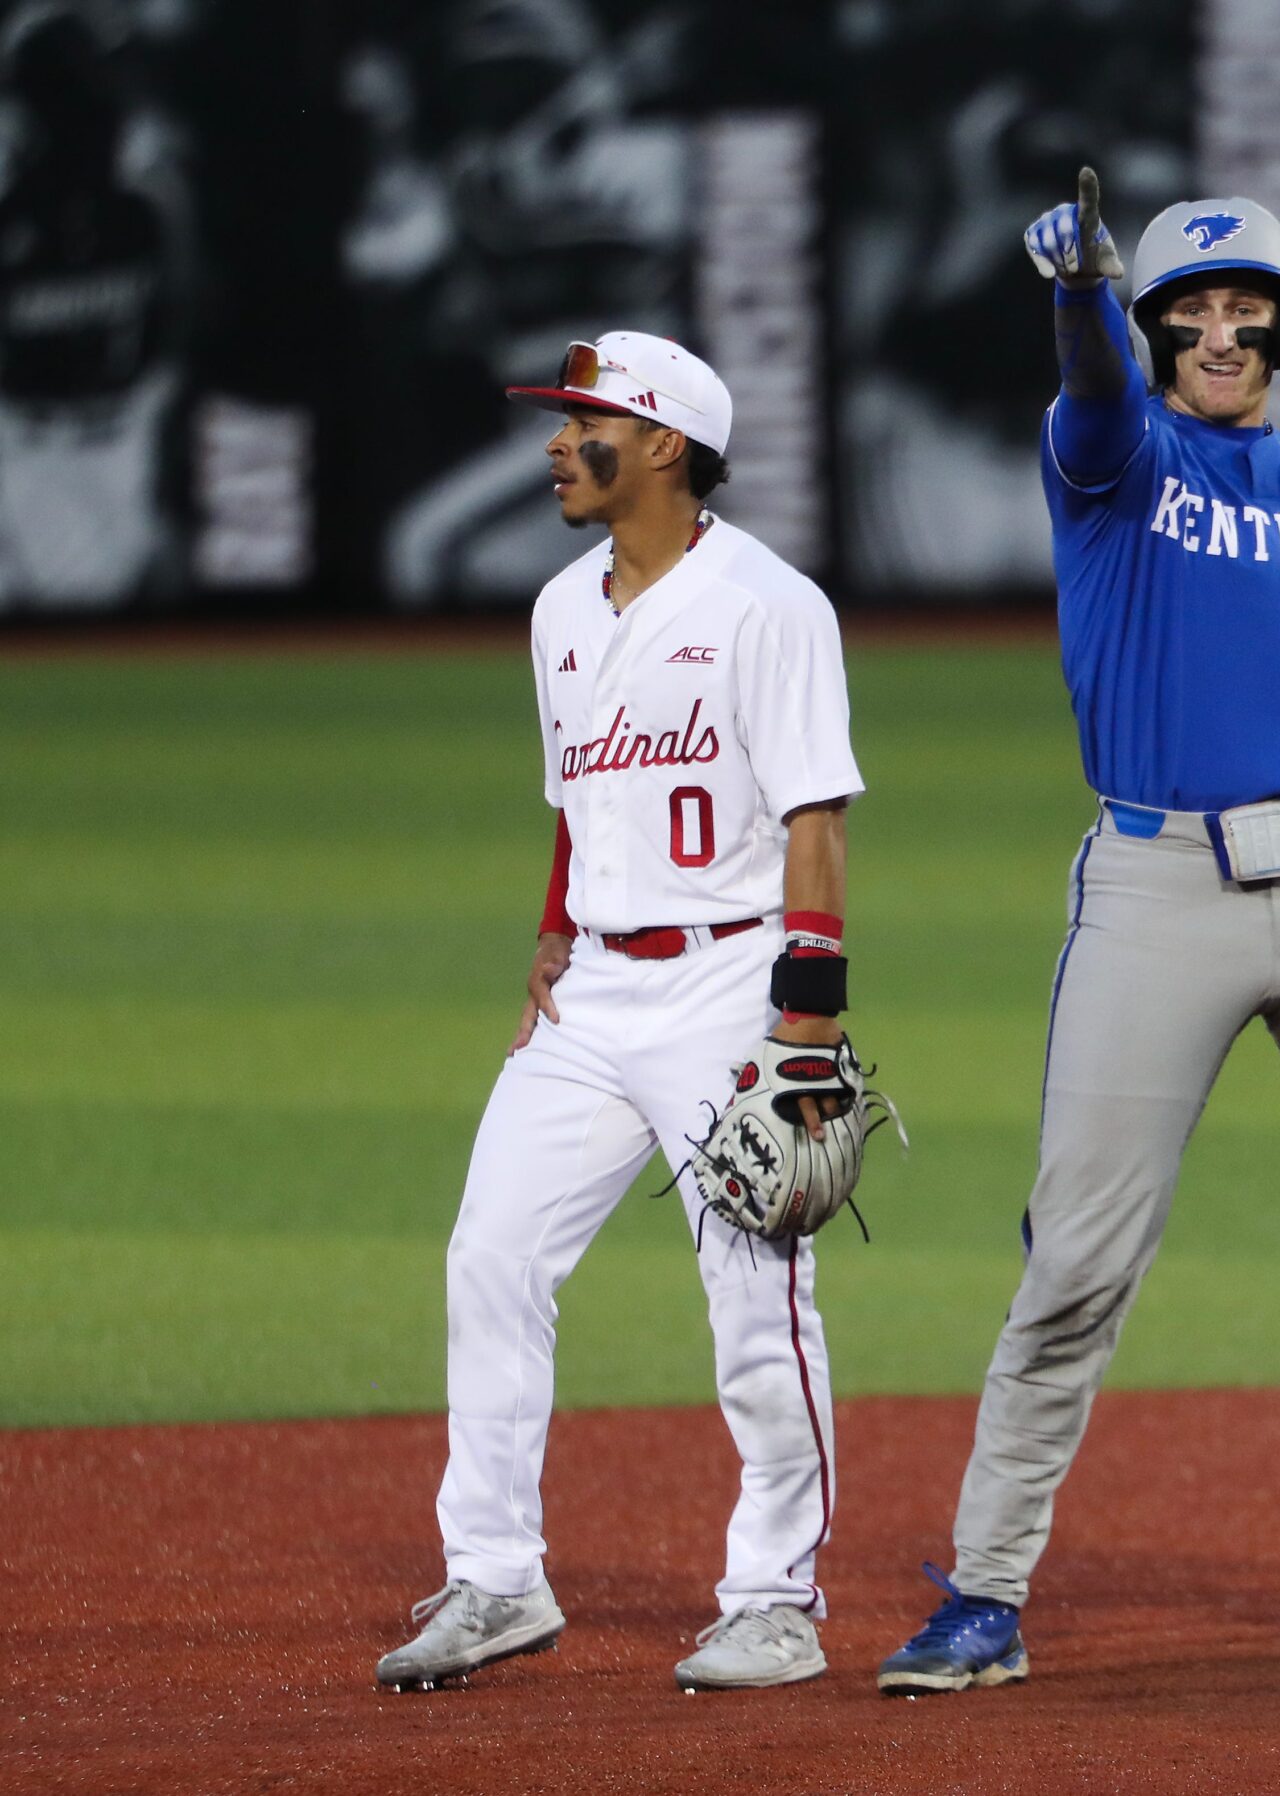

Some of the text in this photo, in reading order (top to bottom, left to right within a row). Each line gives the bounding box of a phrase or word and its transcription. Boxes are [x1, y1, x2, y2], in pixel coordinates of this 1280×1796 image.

[666, 646, 720, 662] ACC
[555, 698, 720, 782] ardinals
[669, 786, 715, 868] 0
[798, 938, 834, 951] ERTIME
